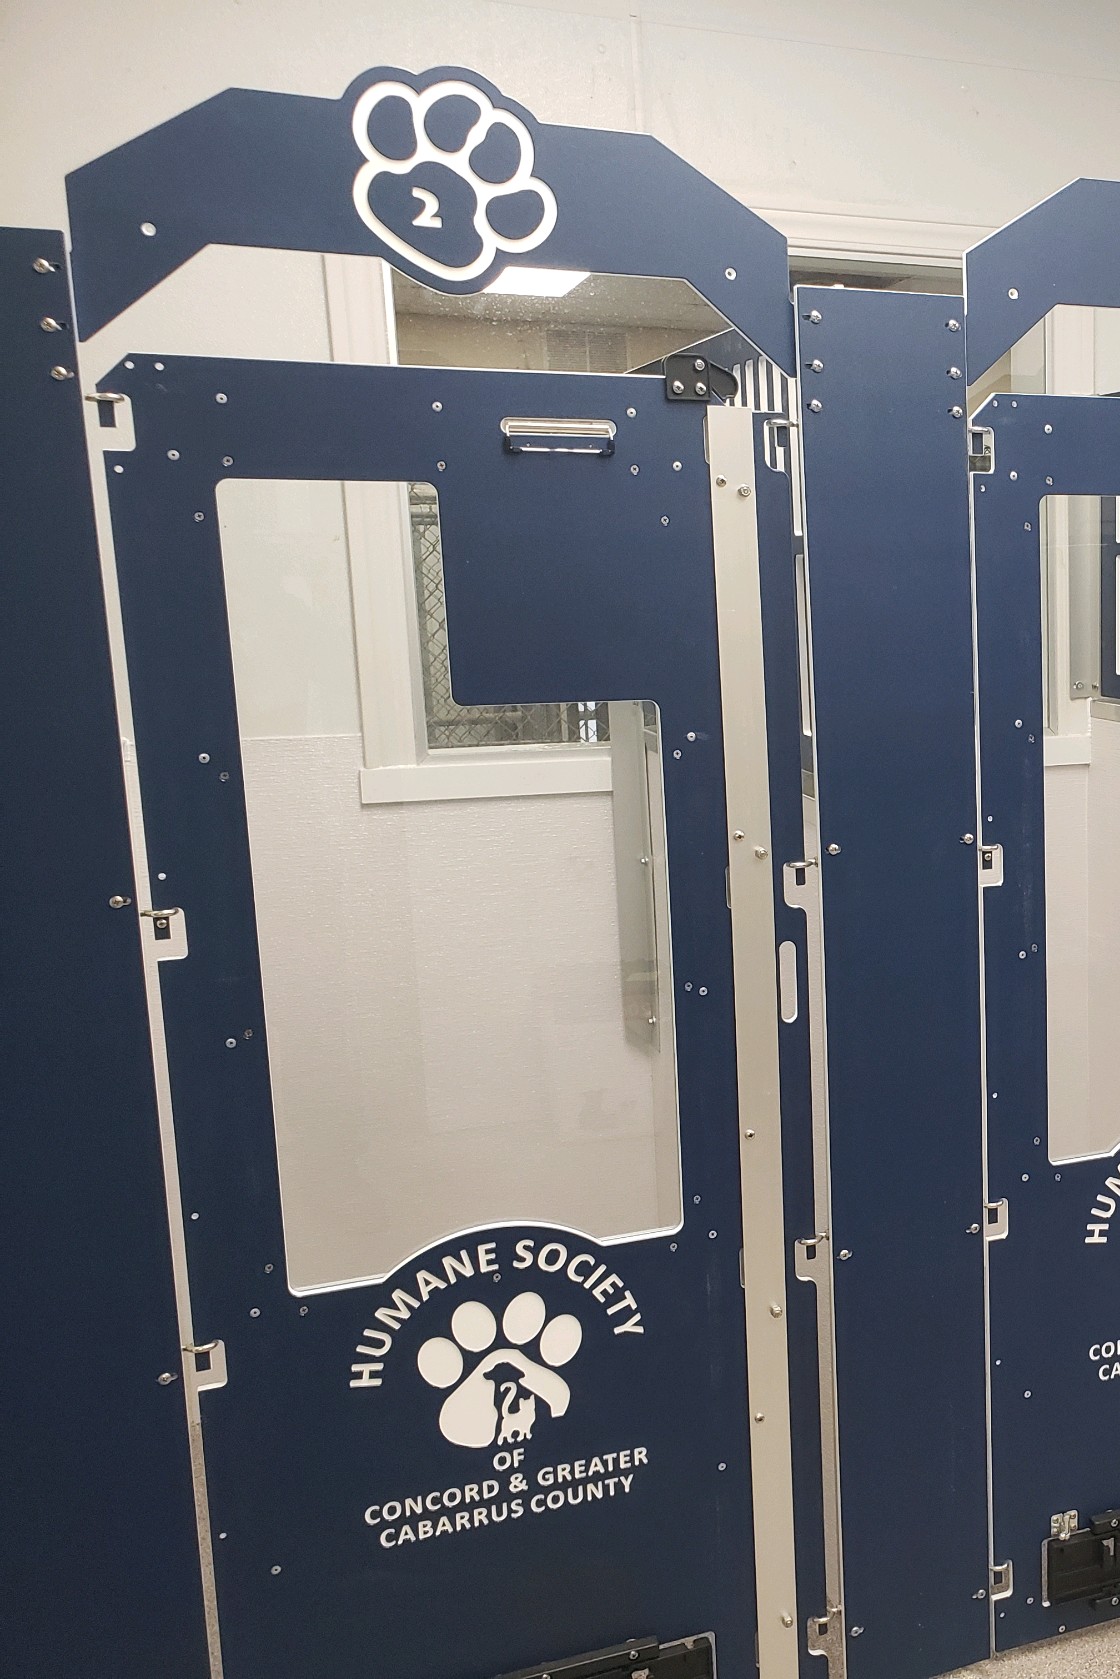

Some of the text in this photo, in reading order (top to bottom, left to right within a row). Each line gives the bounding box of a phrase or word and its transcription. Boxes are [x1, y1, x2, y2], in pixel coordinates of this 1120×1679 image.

[412, 186, 443, 228] 2
[350, 1239, 645, 1388] HUMANE SOCIETY
[364, 1447, 648, 1526] CONCORD & GREATER
[492, 1448, 525, 1472] OF
[380, 1475, 634, 1548] CABARRUS COUNTY
